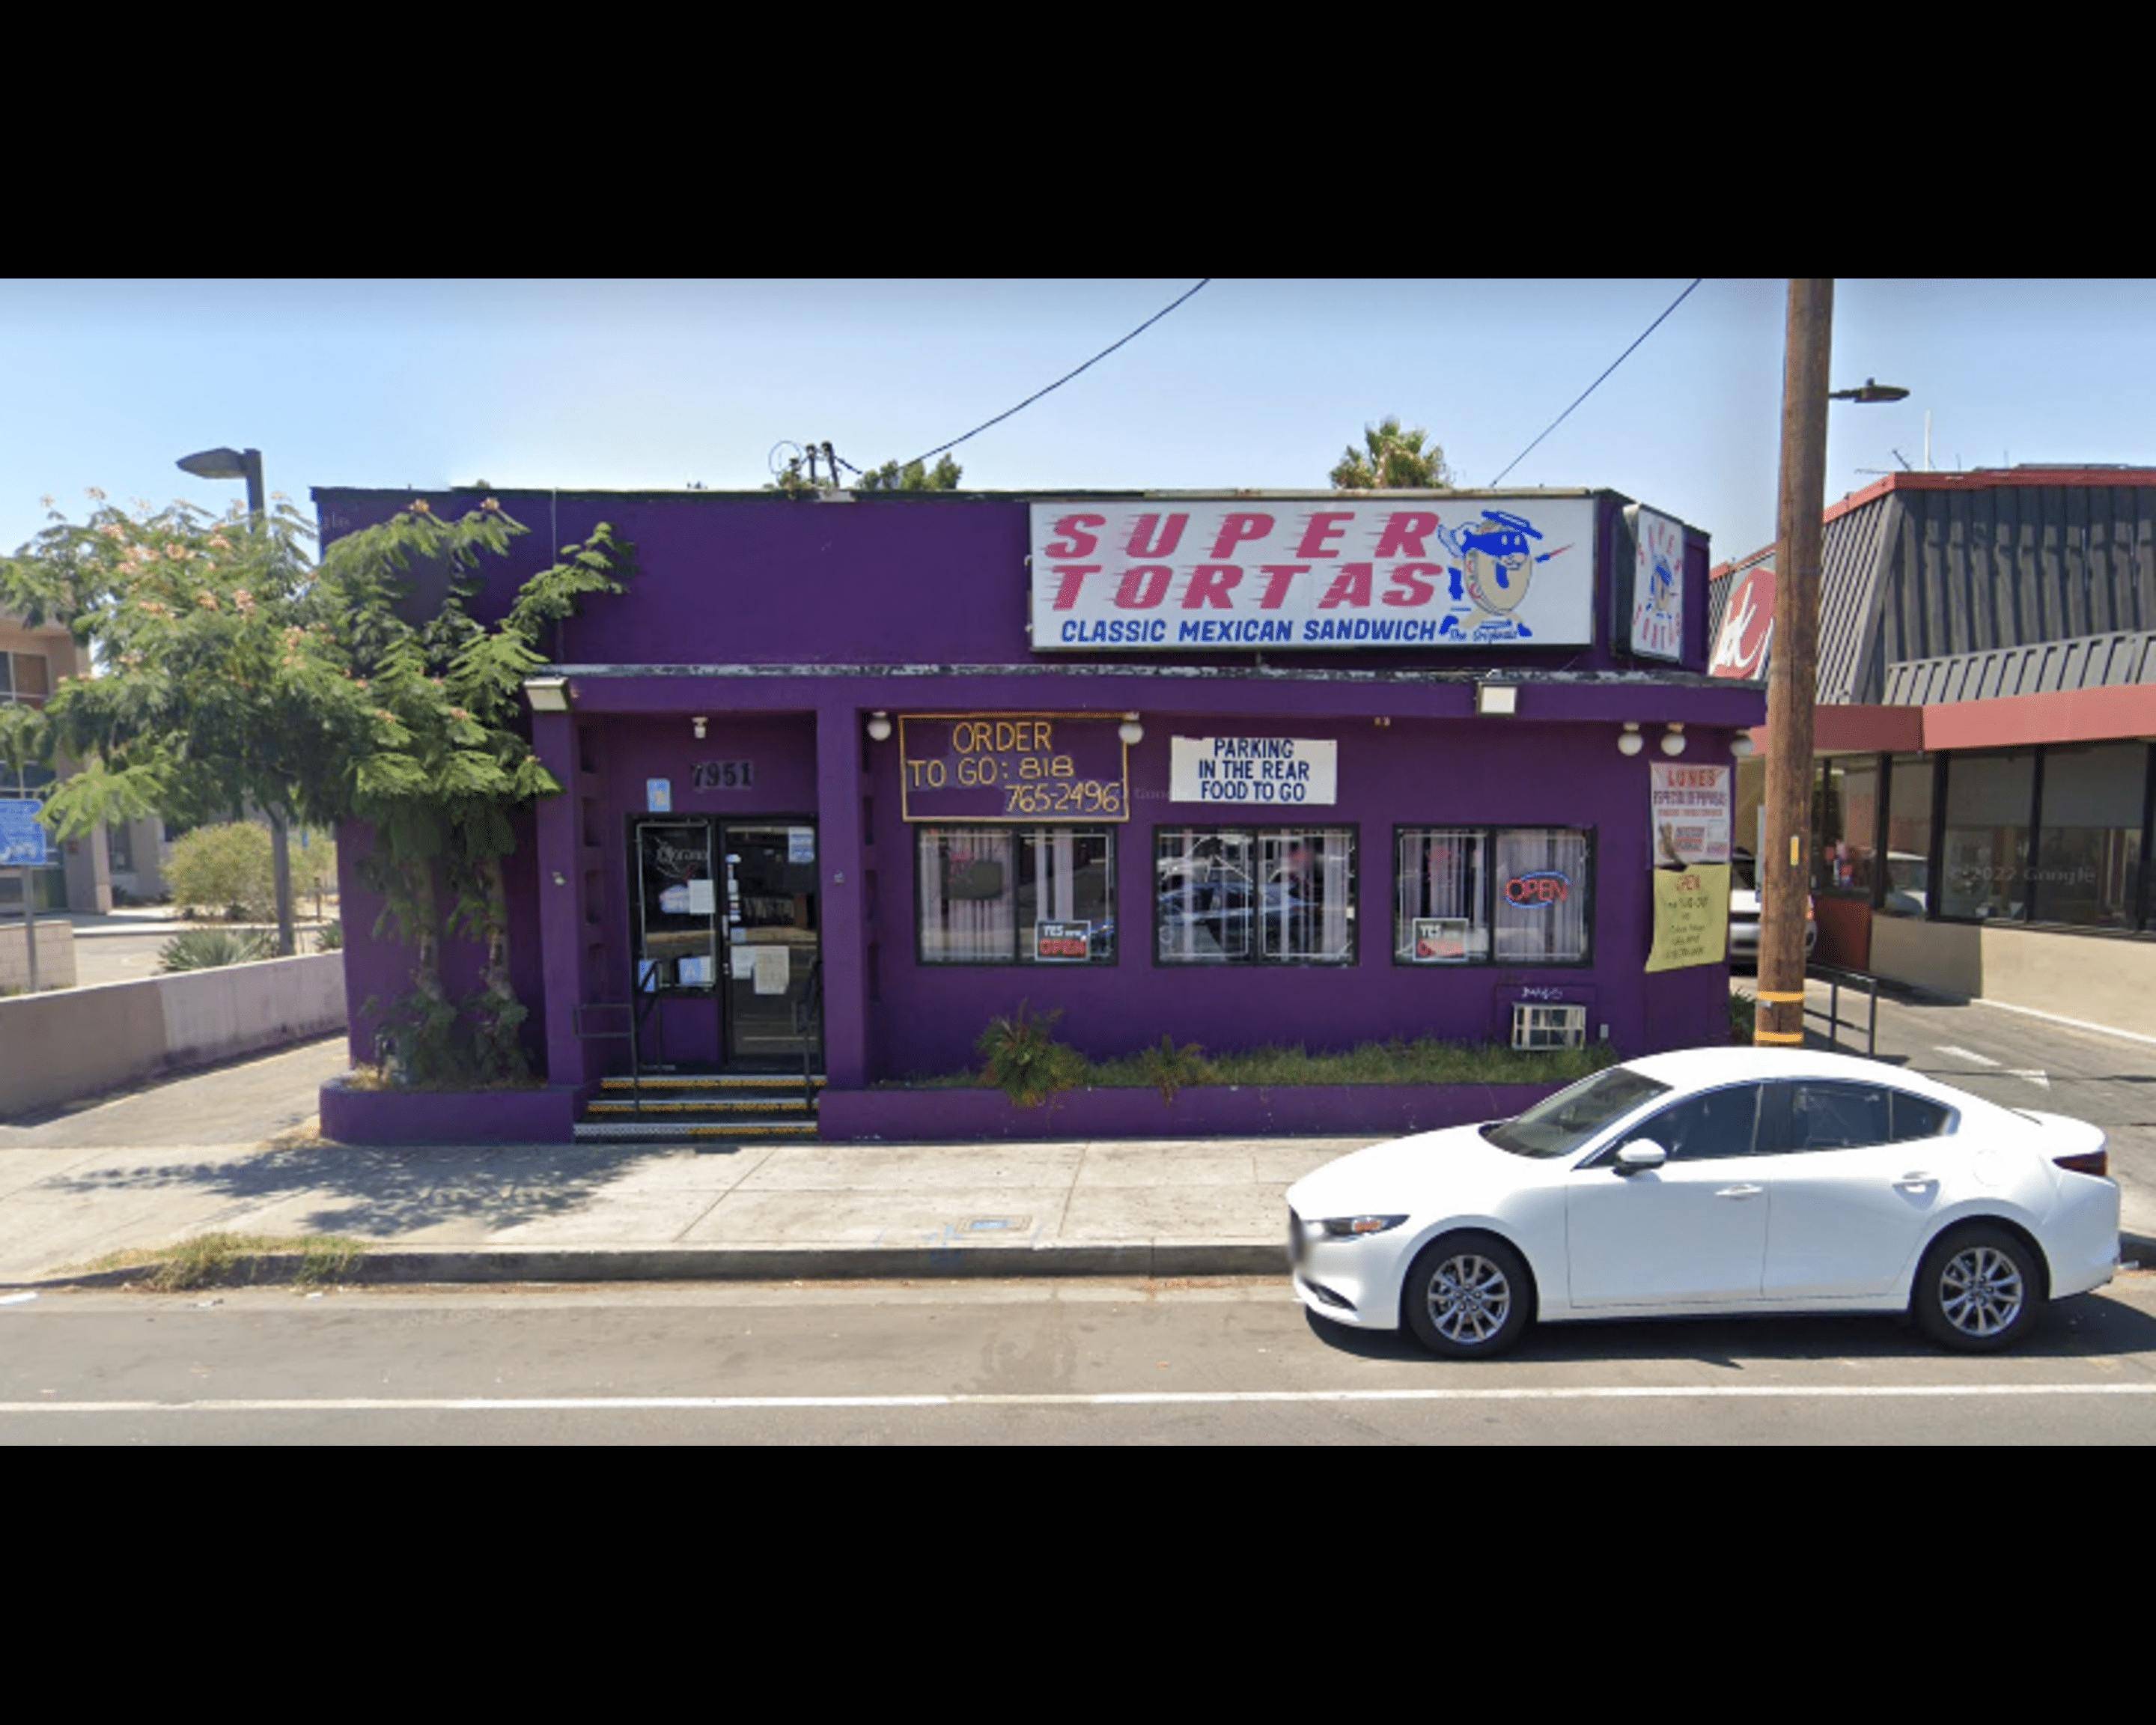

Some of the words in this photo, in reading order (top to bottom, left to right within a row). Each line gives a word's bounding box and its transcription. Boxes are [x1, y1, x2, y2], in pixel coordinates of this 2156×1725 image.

[1044, 512, 1440, 559] SUPER
[1050, 562, 1443, 610] TORTAS
[1062, 620, 1166, 642] CLASSIC
[1179, 620, 1294, 642] MEXICAN
[1303, 619, 1437, 642] SANDWICH
[952, 722, 1052, 754] ORDER
[1213, 738, 1294, 759] PARKING
[689, 761, 752, 788] 7951
[907, 759, 947, 786] TO
[1019, 755, 1075, 779] 818
[1199, 761, 1216, 779] IN
[1222, 760, 1254, 779] THE
[1262, 761, 1309, 780] REAR
[1004, 779, 1121, 812] 765-2496
[1201, 781, 1248, 800] FOOD
[1252, 782, 1272, 801] TO
[1279, 782, 1306, 802] GO
[1504, 878, 1568, 903] OPEN
